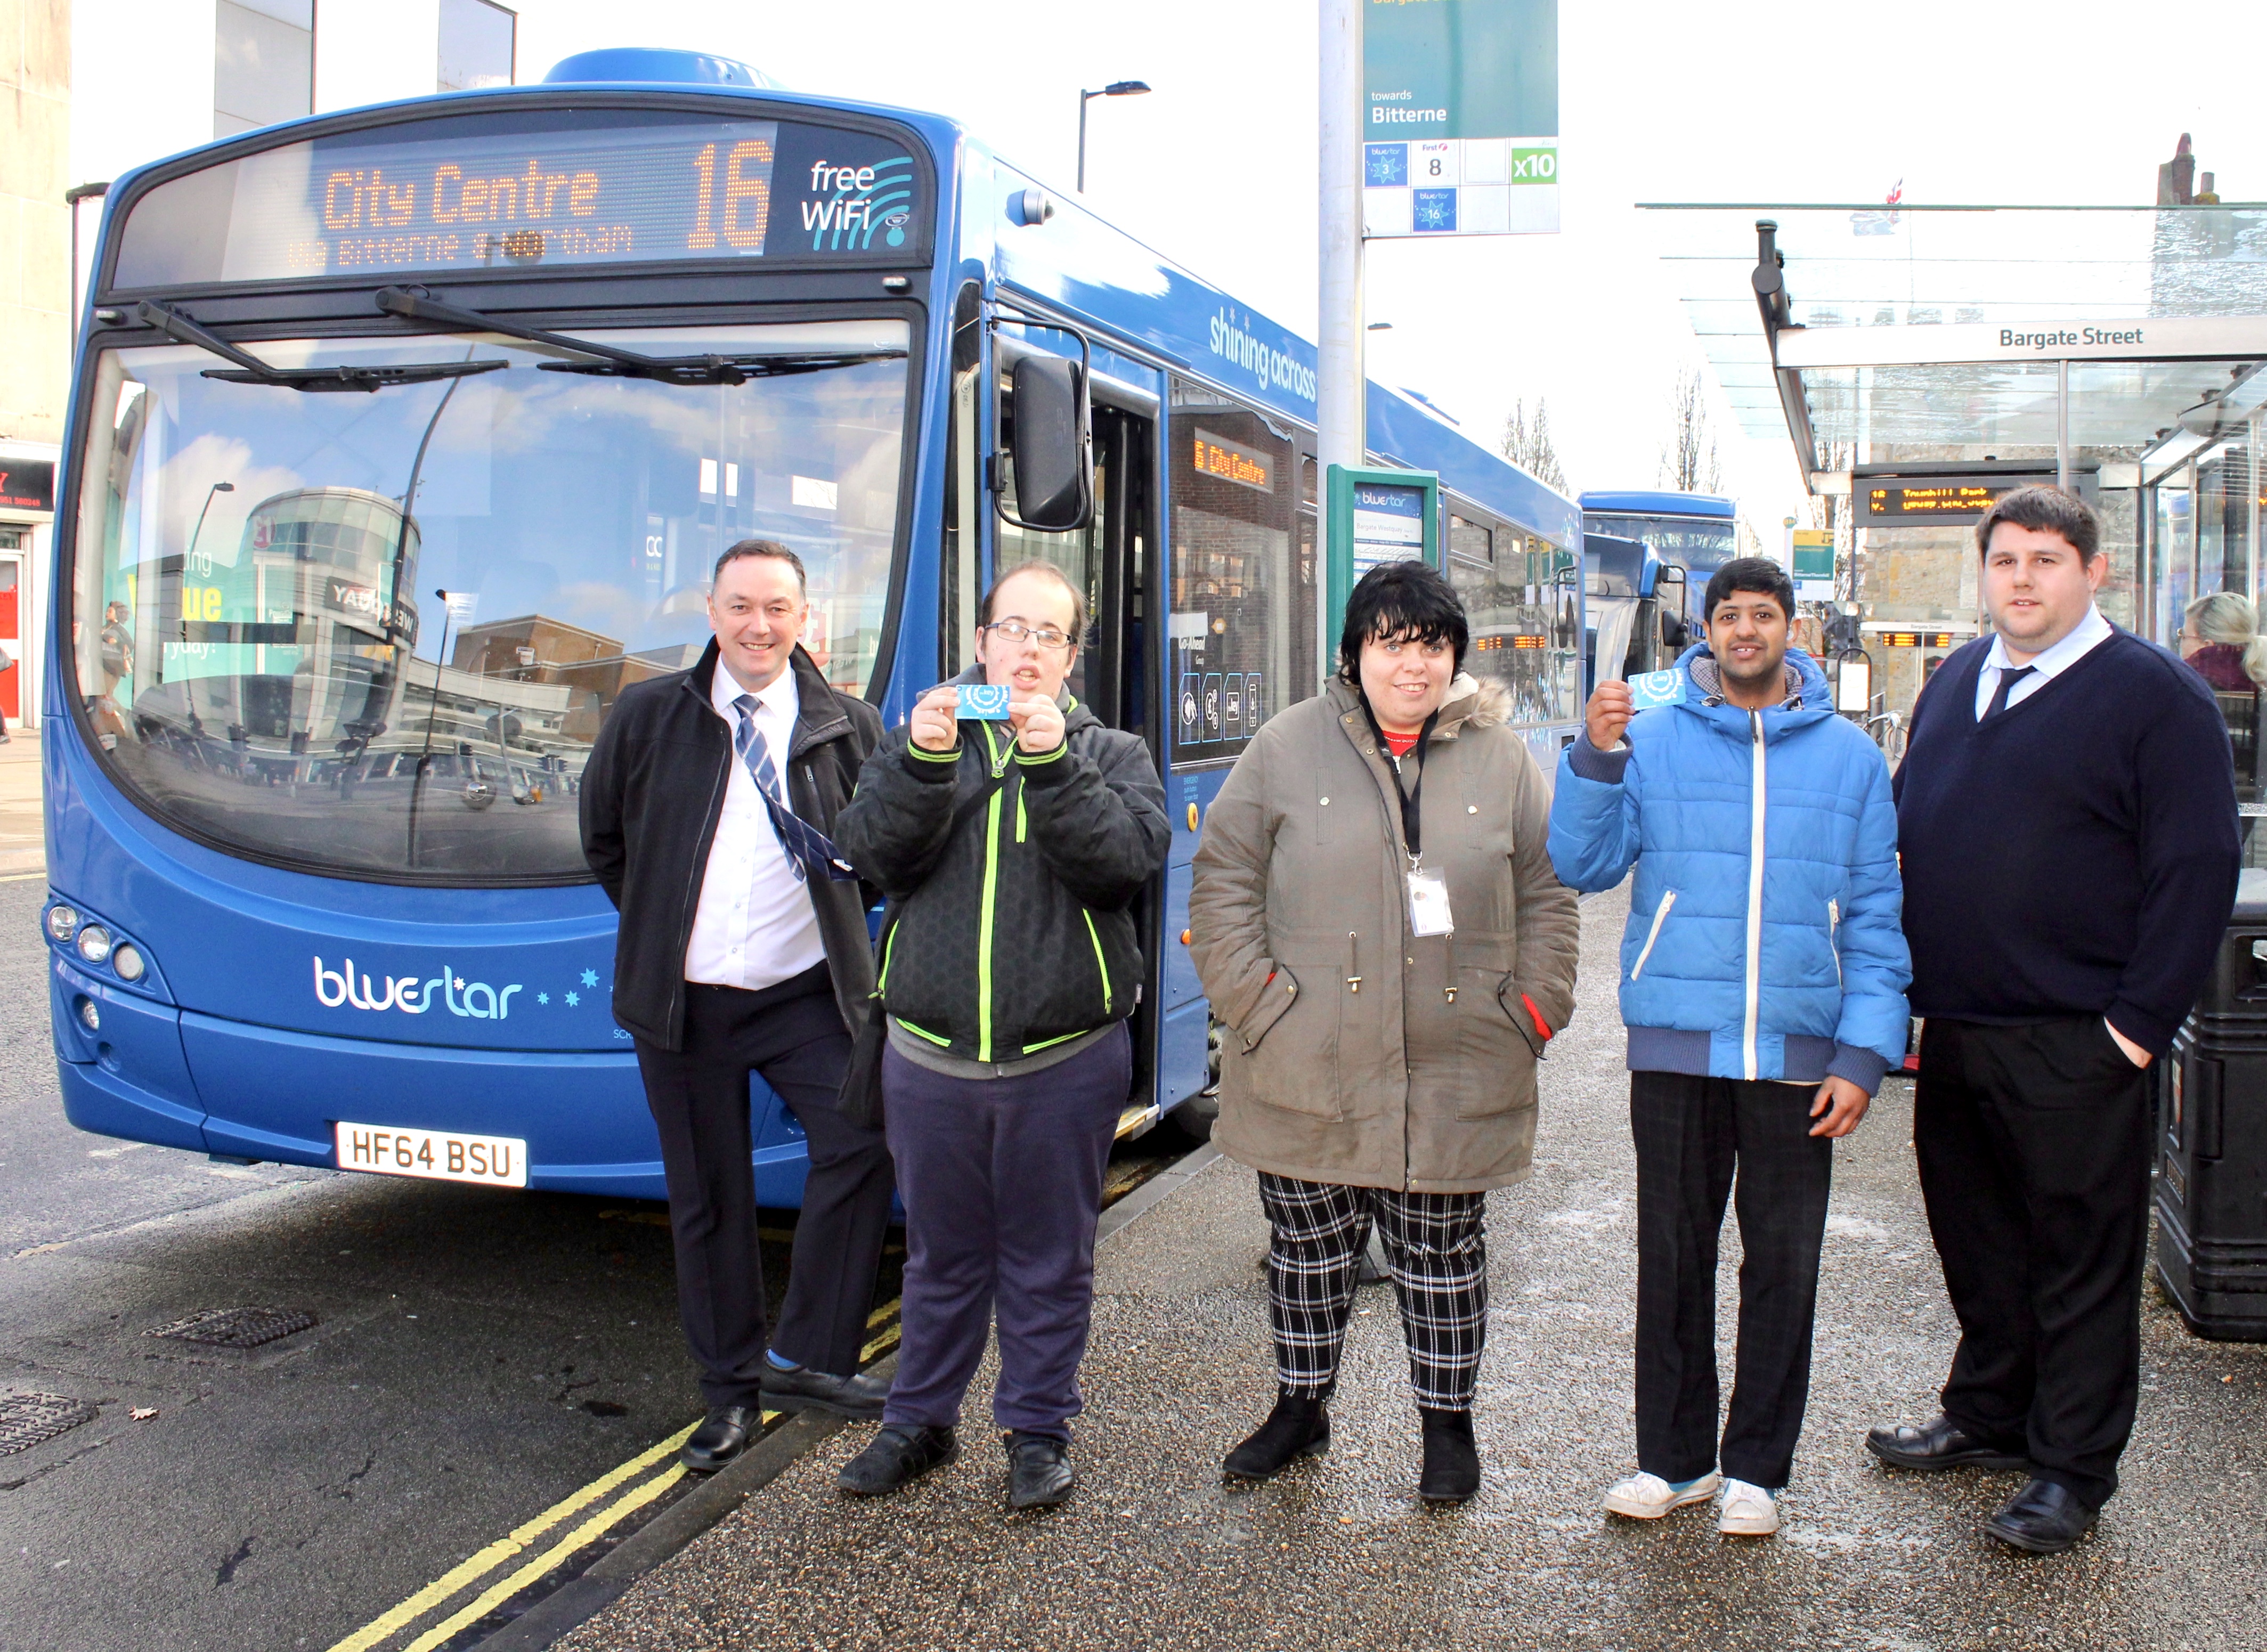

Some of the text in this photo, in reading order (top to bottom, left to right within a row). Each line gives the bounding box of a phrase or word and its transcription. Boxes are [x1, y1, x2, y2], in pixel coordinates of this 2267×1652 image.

[1371, 90, 1412, 101] towards
[1371, 106, 1447, 124] Bitterne
[810, 160, 875, 192] free
[1382, 164, 1390, 175] 3
[1429, 158, 1442, 176] 8
[1514, 153, 1556, 178] x10
[324, 160, 599, 229] City Centre
[687, 141, 772, 249] 16
[801, 199, 872, 232] WiFi
[1427, 208, 1440, 219] 16
[1999, 327, 2144, 350] Bargate Street
[1210, 306, 1316, 403] shining across
[1209, 445, 1230, 477] City
[1232, 453, 1265, 485] Centre
[1362, 491, 1407, 507] bluestar
[1356, 523, 1377, 531] Bargate
[1178, 635, 1206, 650] Go-Ahead
[314, 956, 523, 1020] bluestar
[353, 1130, 510, 1177] HF64 BSU
